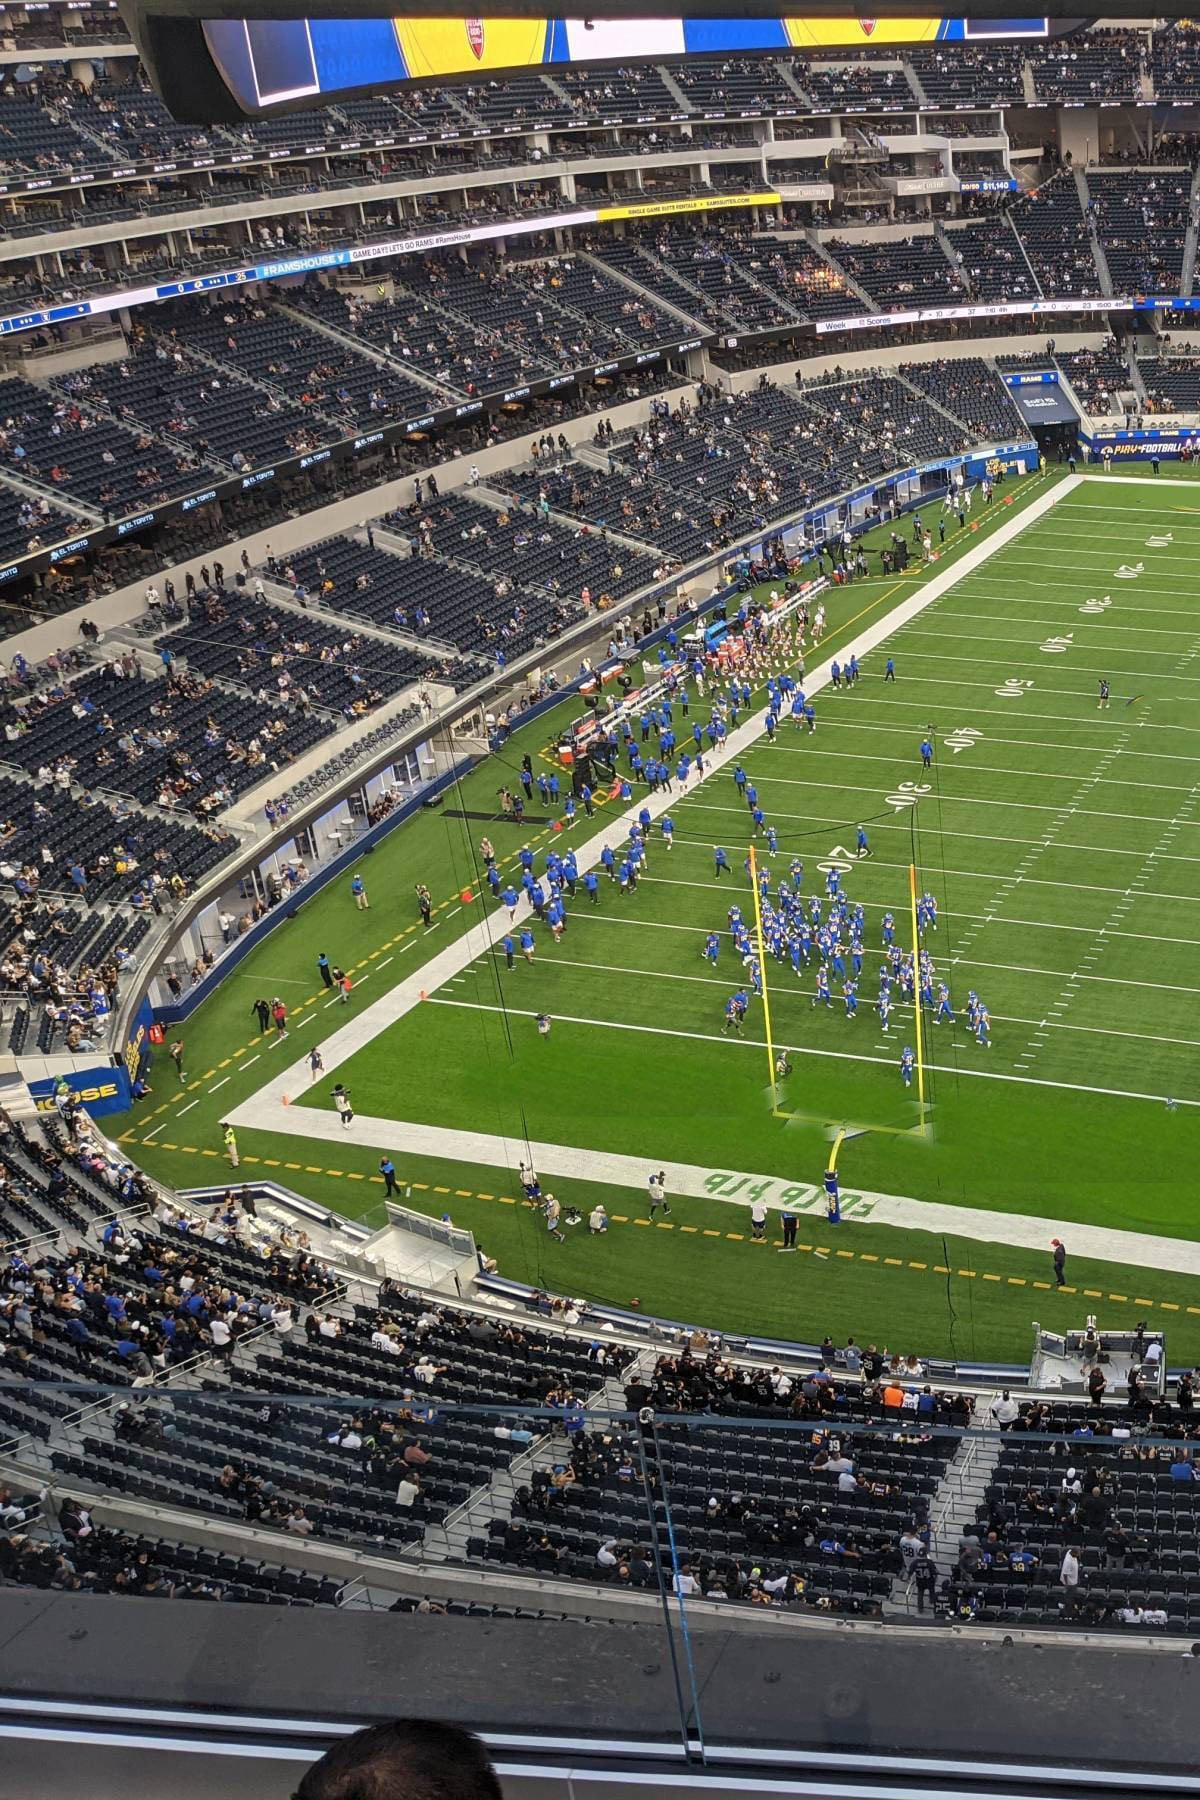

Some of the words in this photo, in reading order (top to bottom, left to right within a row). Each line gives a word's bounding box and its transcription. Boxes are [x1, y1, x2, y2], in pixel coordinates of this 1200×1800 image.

[983, 182, 1009, 190] $11,140
[353, 251, 371, 259] GAME
[389, 244, 404, 253] LETS
[405, 242, 415, 250] GO
[263, 255, 337, 275] #RAMSHOUSE
[826, 321, 846, 330] Week
[866, 317, 891, 325] Scores
[1020, 375, 1043, 383] RAMS
[467, 401, 483, 410] TORITO
[418, 416, 434, 426] TORITO
[367, 433, 384, 442] TORITO
[1140, 442, 1181, 453] FOOTBALL
[313, 450, 330, 460] TORITO
[255, 469, 275, 480] TORITO
[196, 491, 216, 501] TORITO
[133, 513, 154, 525] TORITO
[67, 539, 88, 551] TORITO
[1145, 535, 1173, 547] 10
[0, 566, 18, 579] ORITO
[1113, 565, 1144, 578] 20
[1078, 598, 1112, 613] 30
[1040, 636, 1073, 652] 40
[994, 679, 1034, 697] 50
[943, 727, 984, 747] 40
[885, 782, 932, 805] 30
[816, 845, 869, 873] 20
